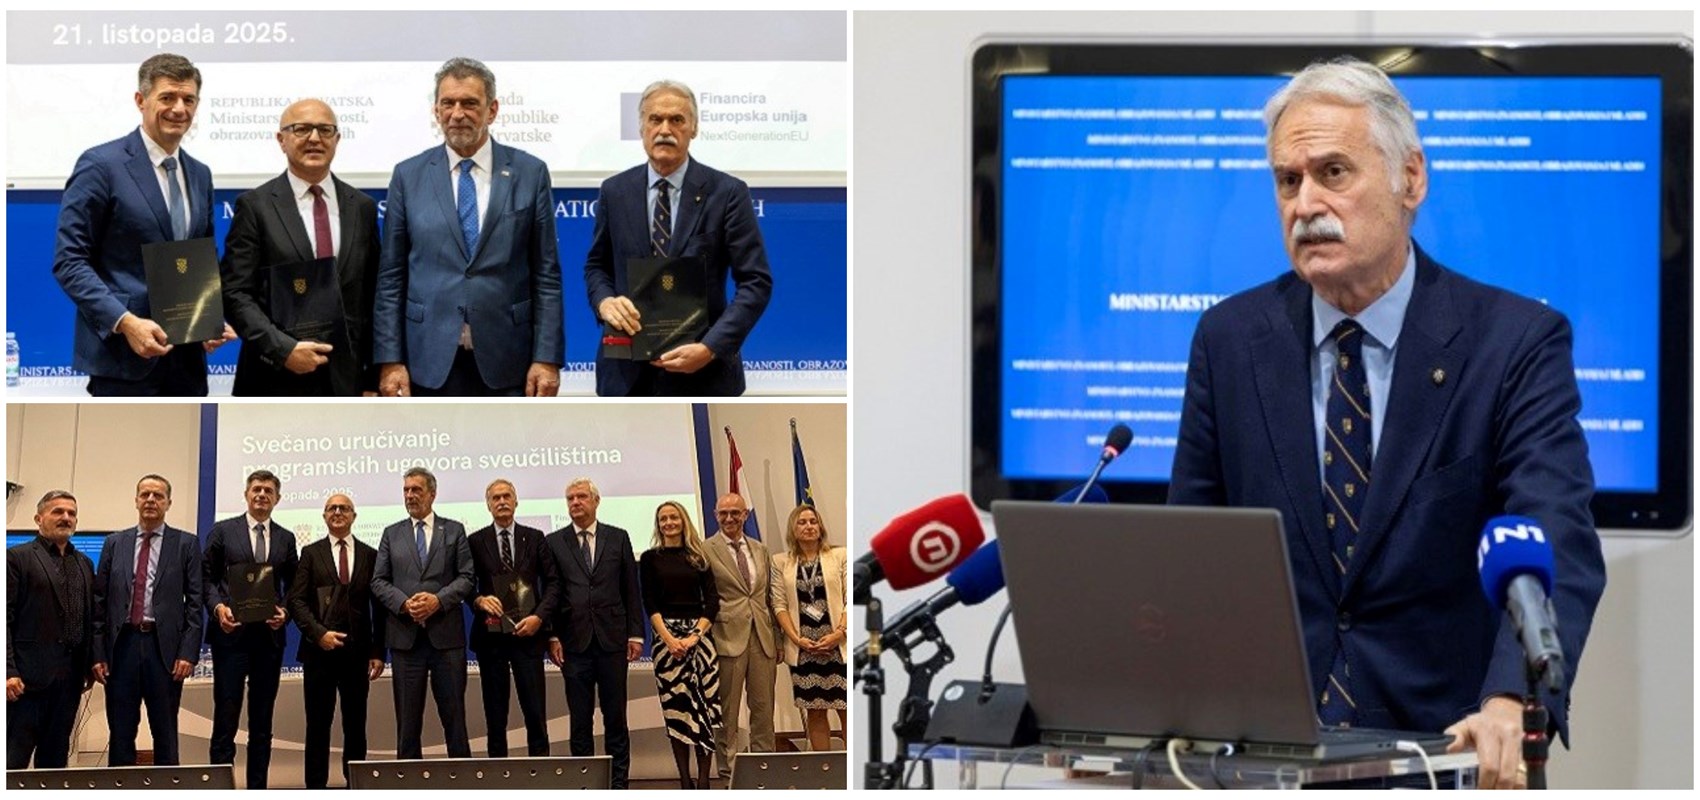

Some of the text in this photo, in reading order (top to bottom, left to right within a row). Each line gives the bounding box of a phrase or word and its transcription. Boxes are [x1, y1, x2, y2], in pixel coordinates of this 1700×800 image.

[53, 22, 296, 49] 21. listopada 2025.
[498, 92, 524, 105] ada
[700, 93, 766, 104] Financira
[210, 111, 369, 124] Ministars osti,
[495, 110, 559, 126] epublike
[701, 109, 808, 124] Europska unija
[210, 129, 271, 140] obrazova
[493, 128, 552, 142] rvatske
[700, 130, 809, 141] NextGenerationEU
[1109, 293, 1223, 311] MINISTARSTV
[242, 429, 451, 454] Svečano uručivanje
[479, 447, 622, 470] sveučilištima
[283, 488, 320, 503] opada
[1493, 523, 1545, 543] N1
